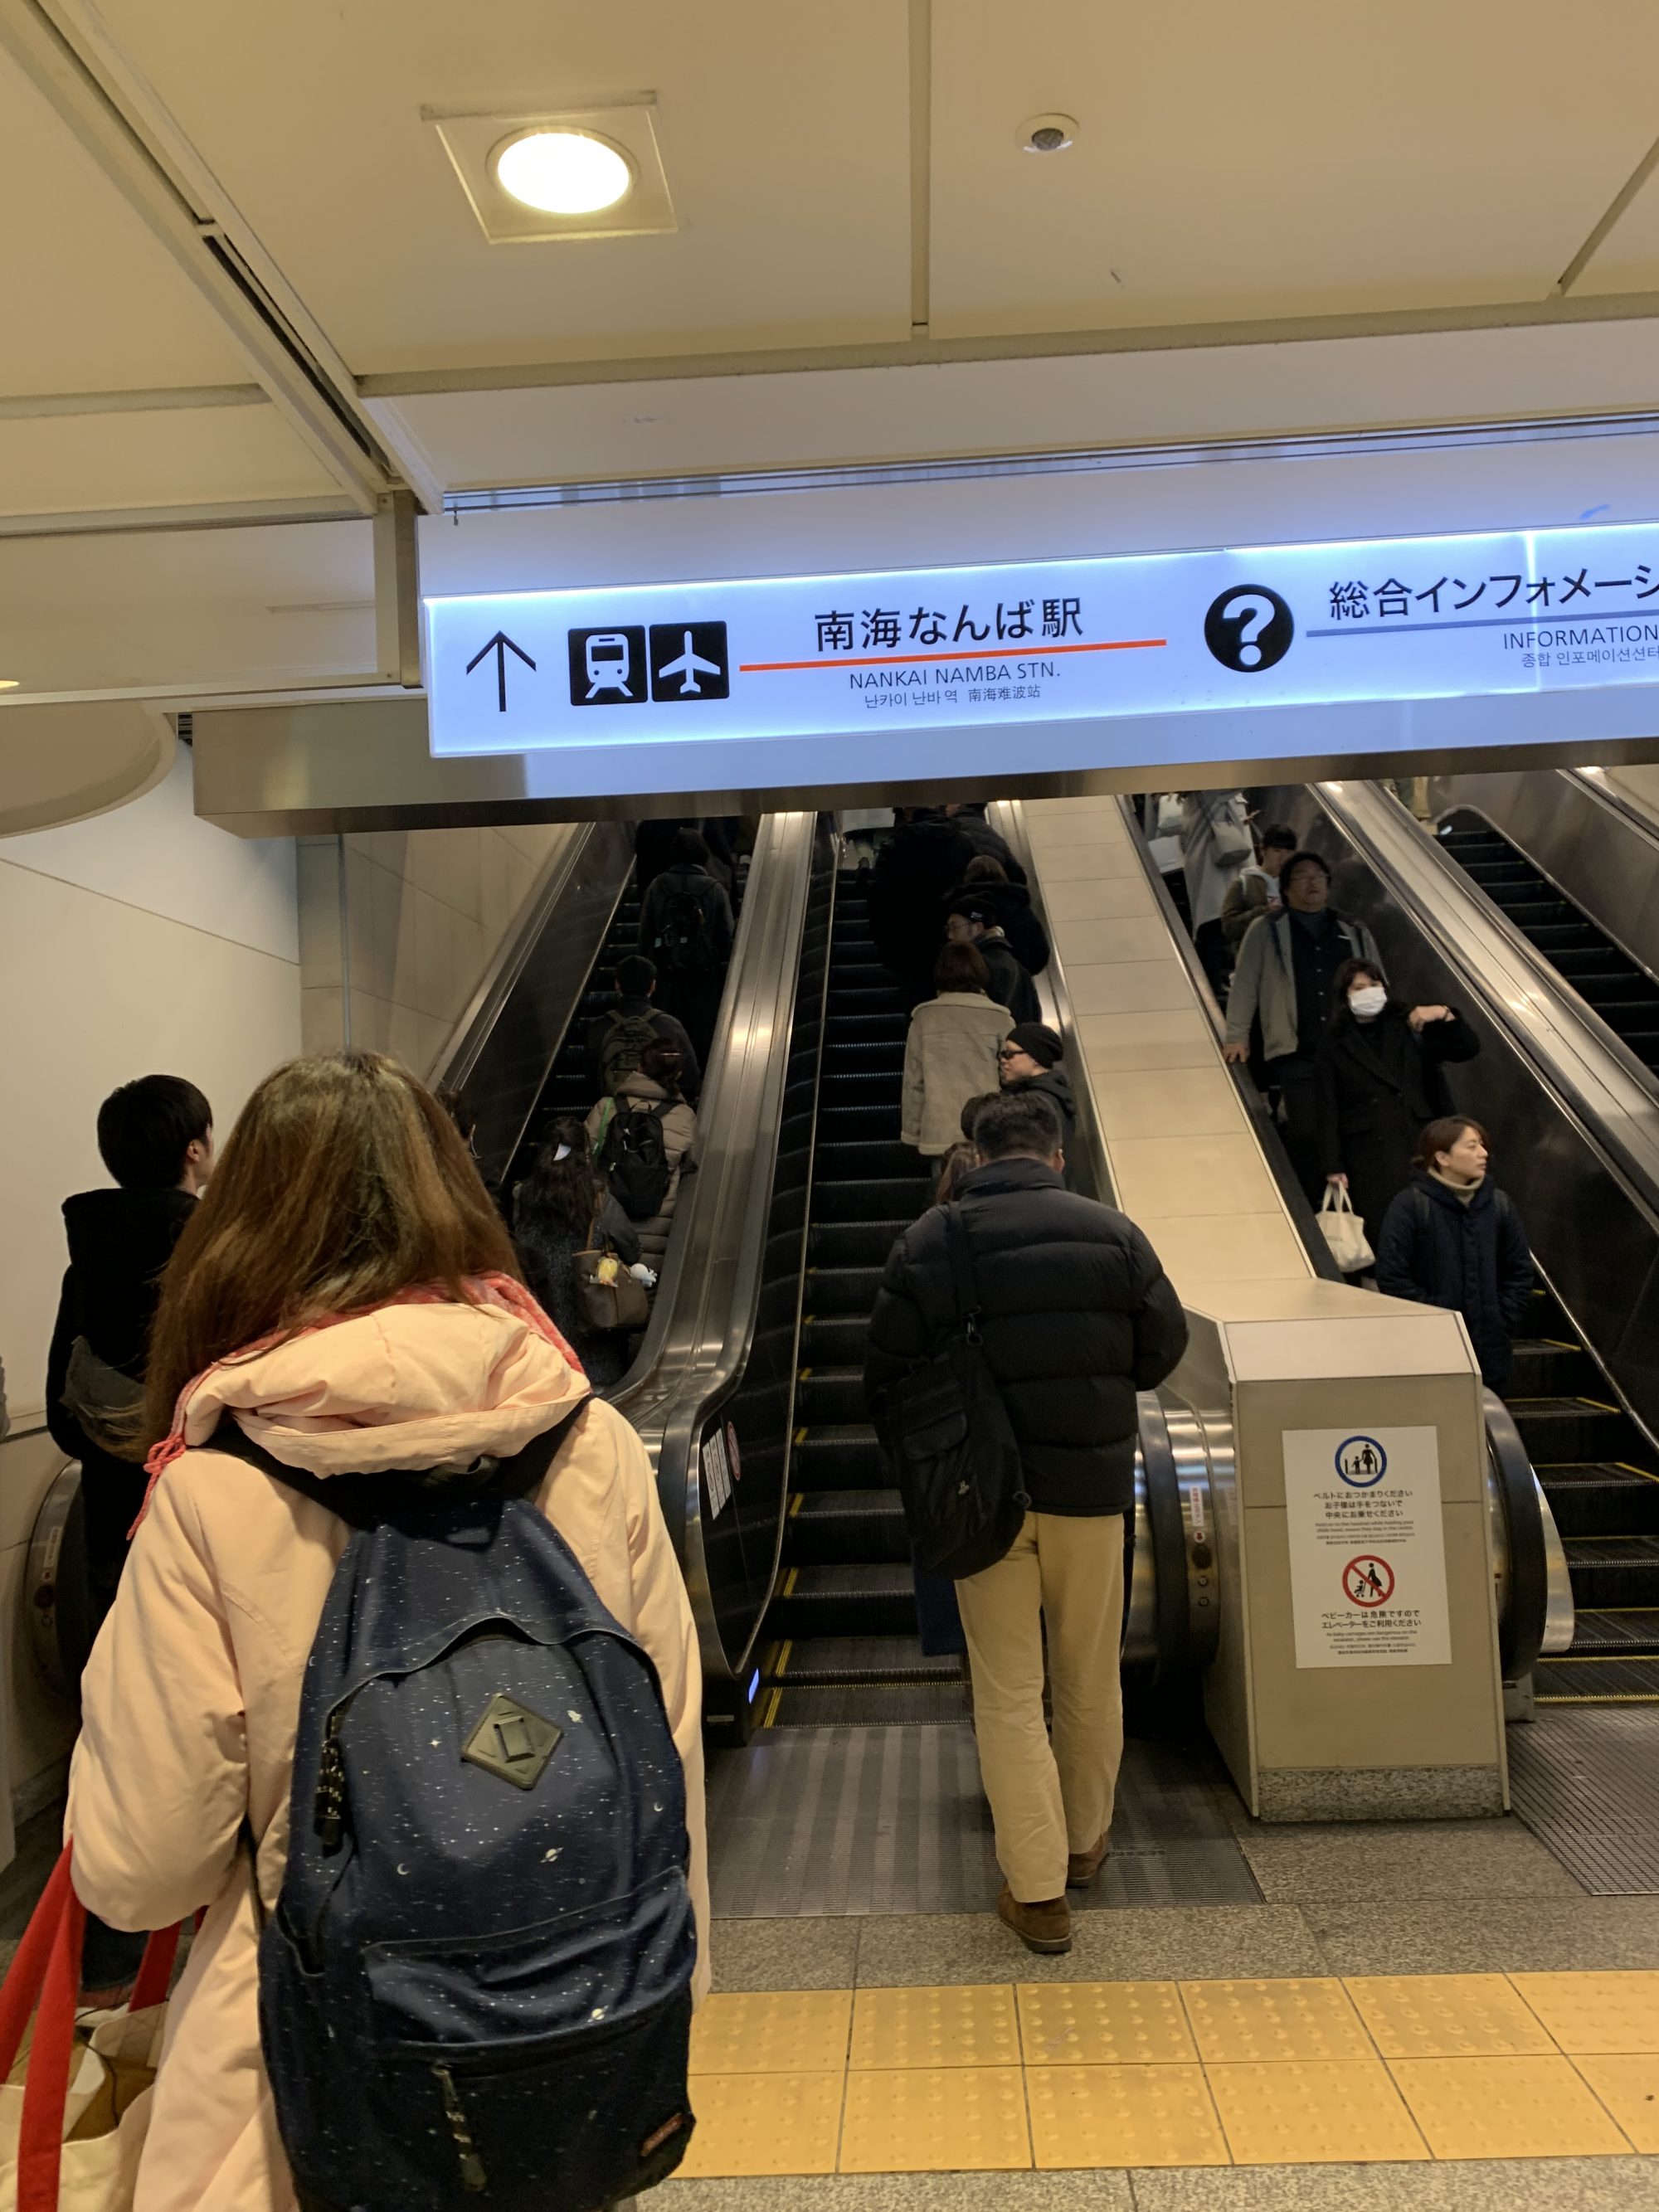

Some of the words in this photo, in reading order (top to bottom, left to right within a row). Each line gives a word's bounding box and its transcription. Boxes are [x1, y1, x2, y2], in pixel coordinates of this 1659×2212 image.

[1329, 565, 1659, 620] 総合インフォメーシ
[815, 597, 1083, 652] 南海なんば駅
[1503, 624, 1658, 649] INFORMATION
[1521, 652, 1551, 668] 종합
[850, 668, 927, 689] NANKAI
[936, 664, 1011, 684] NAMBA
[1017, 661, 1061, 679] STN.
[864, 692, 907, 709] 난카이
[912, 690, 941, 706] 난바
[944, 689, 958, 703] 역
[968, 684, 1041, 702] 南海难波站
[1313, 1490, 1413, 1500] ベルトにおつかまりください
[1321, 1610, 1420, 1619] ベビーカーは危険ですので
[1321, 1619, 1422, 1629] エレベーターをご利用ください
